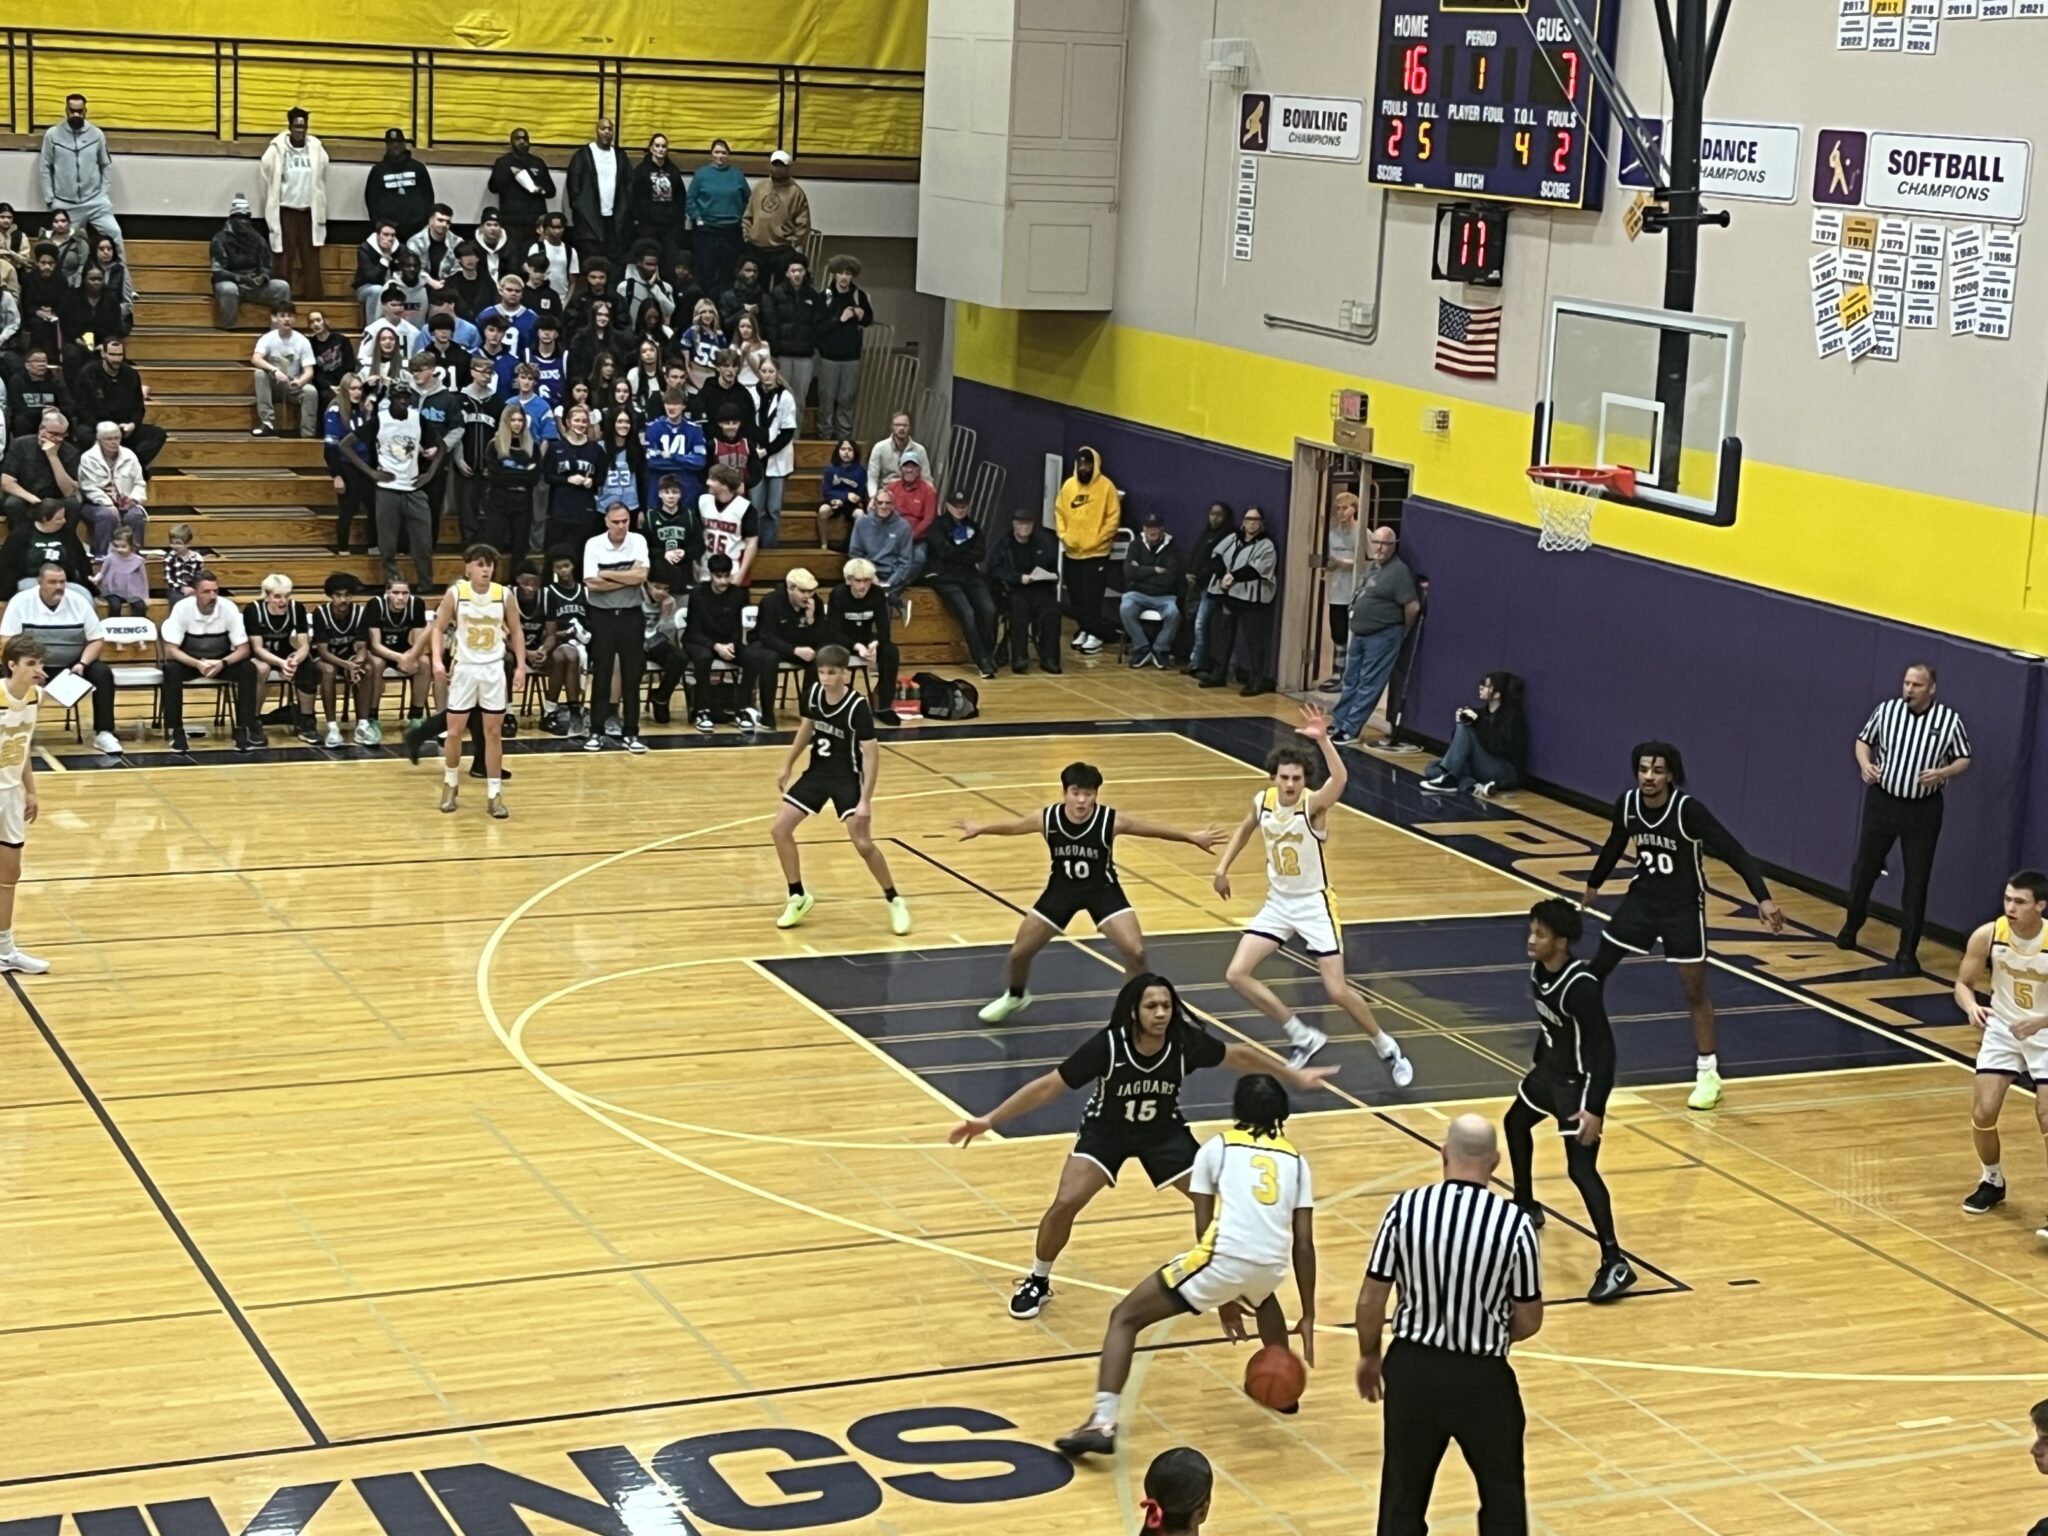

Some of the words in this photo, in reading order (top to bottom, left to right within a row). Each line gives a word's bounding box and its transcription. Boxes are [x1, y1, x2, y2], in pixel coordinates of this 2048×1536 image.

[1394, 15, 1428, 38] HOME
[1466, 30, 1497, 47] PERIOD
[1403, 45, 1428, 95] 16
[1478, 57, 1486, 90] 1
[1562, 52, 1578, 100] 7
[1382, 100, 1408, 117] FOULS
[1448, 104, 1480, 121] PLAYER
[1483, 106, 1504, 123] FOUL
[1283, 108, 1348, 132] BOWLING
[1547, 111, 1577, 128] FOULS
[1288, 131, 1341, 147] CHAMPIONS
[1388, 119, 1403, 157] 2
[1418, 121, 1431, 160] 5
[1515, 131, 1530, 165] 4
[1553, 131, 1570, 173] 2
[1702, 138, 1758, 164] DANCE
[1376, 165, 1402, 182] SCORE
[1700, 165, 1766, 184] HAMPIONS
[1888, 149, 2004, 183] SOFTBALL
[1454, 172, 1484, 190] MATCH
[1540, 181, 1571, 199] SCORE
[1897, 180, 1990, 201] CHAMPIONS
[607, 470, 631, 486] 23
[105, 626, 148, 635] VIKINGS
[818, 738, 831, 757] 2
[1054, 845, 1099, 859] JAGUARS
[1640, 851, 1673, 874] 20
[1064, 860, 1090, 879] 10
[2014, 981, 2033, 1009] 5
[1116, 1080, 1175, 1095] JAGUARS
[1124, 1100, 1157, 1122] 15
[1250, 1154, 1278, 1206] 3
